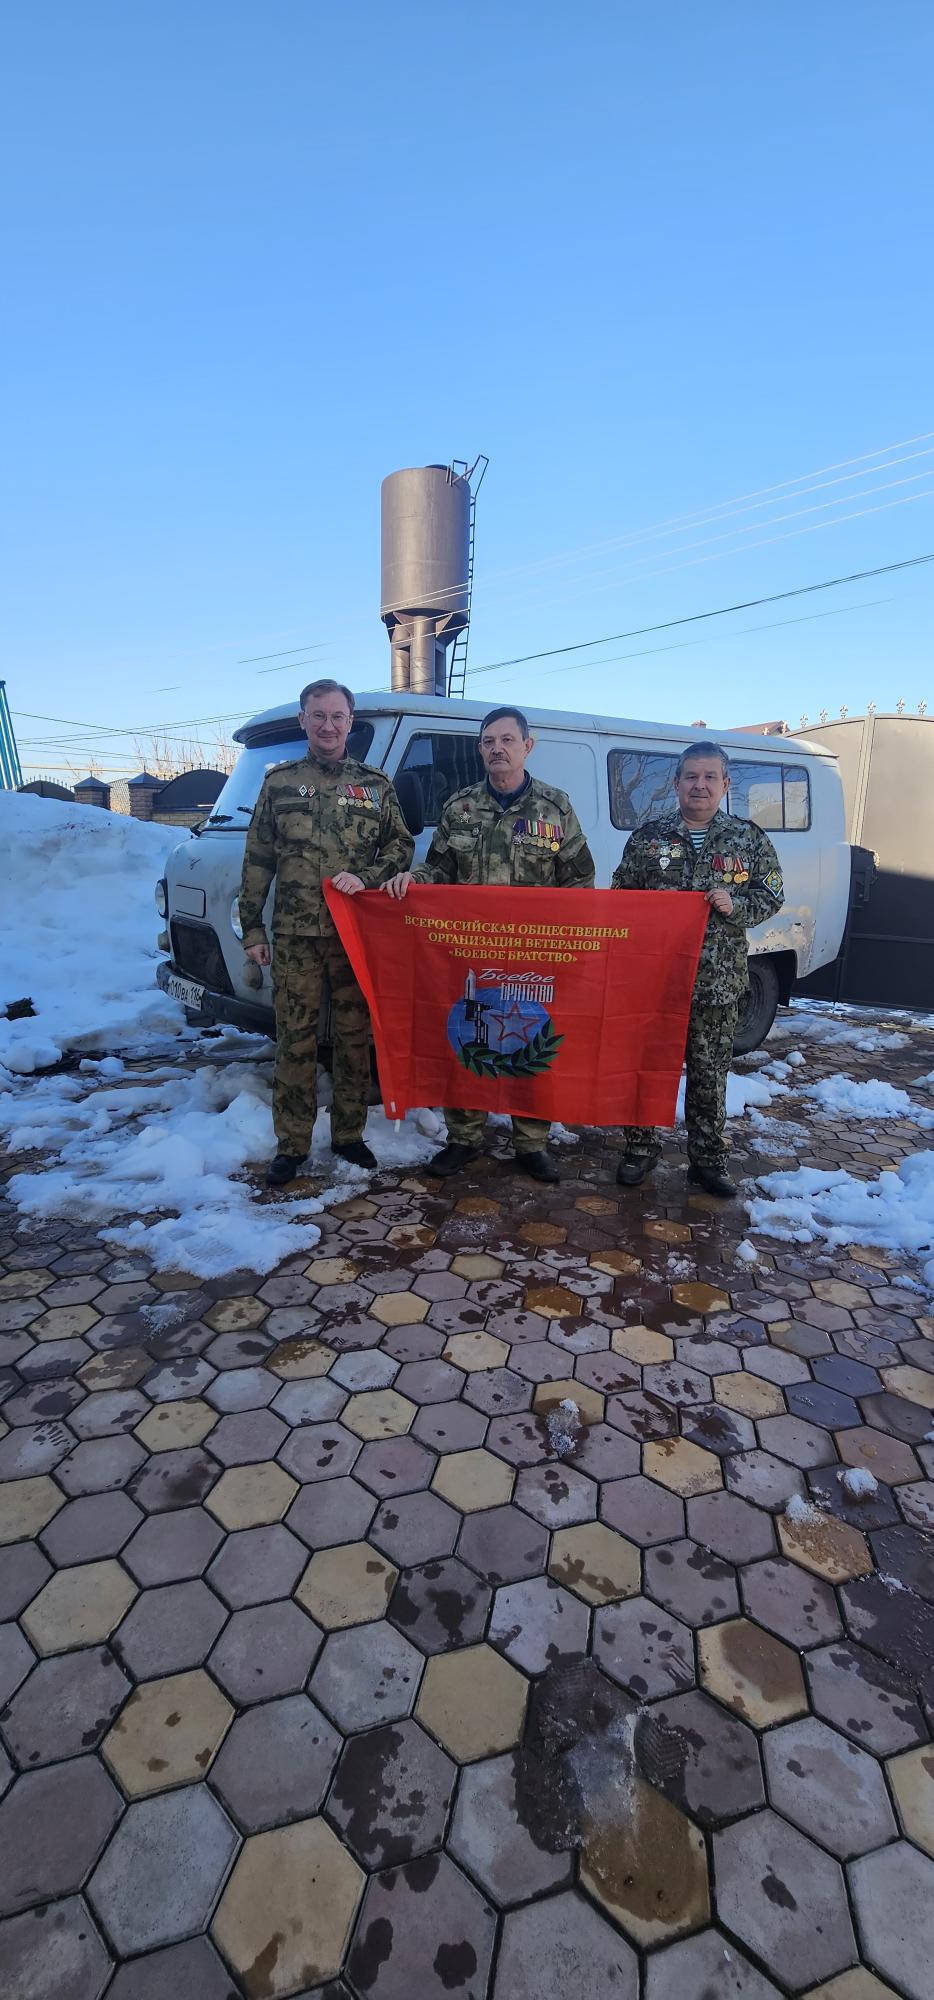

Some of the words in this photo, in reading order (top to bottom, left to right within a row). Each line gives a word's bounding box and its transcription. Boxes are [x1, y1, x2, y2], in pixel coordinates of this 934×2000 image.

[404, 915, 516, 934] ВСЕРОССИЙСКАЯ
[518, 924, 629, 939] ОБЩЕСТВЕННАЯ
[428, 932, 522, 948] ОРГАНИЗАЦИЯ
[526, 938, 601, 952] ВЕТЕРАНОВ
[448, 948, 506, 960] «БОЕВОЕ
[507, 950, 578, 962] БРАТСТВО»
[478, 968, 556, 983] Боевое
[500, 982, 554, 1003] БРАТСТВО
